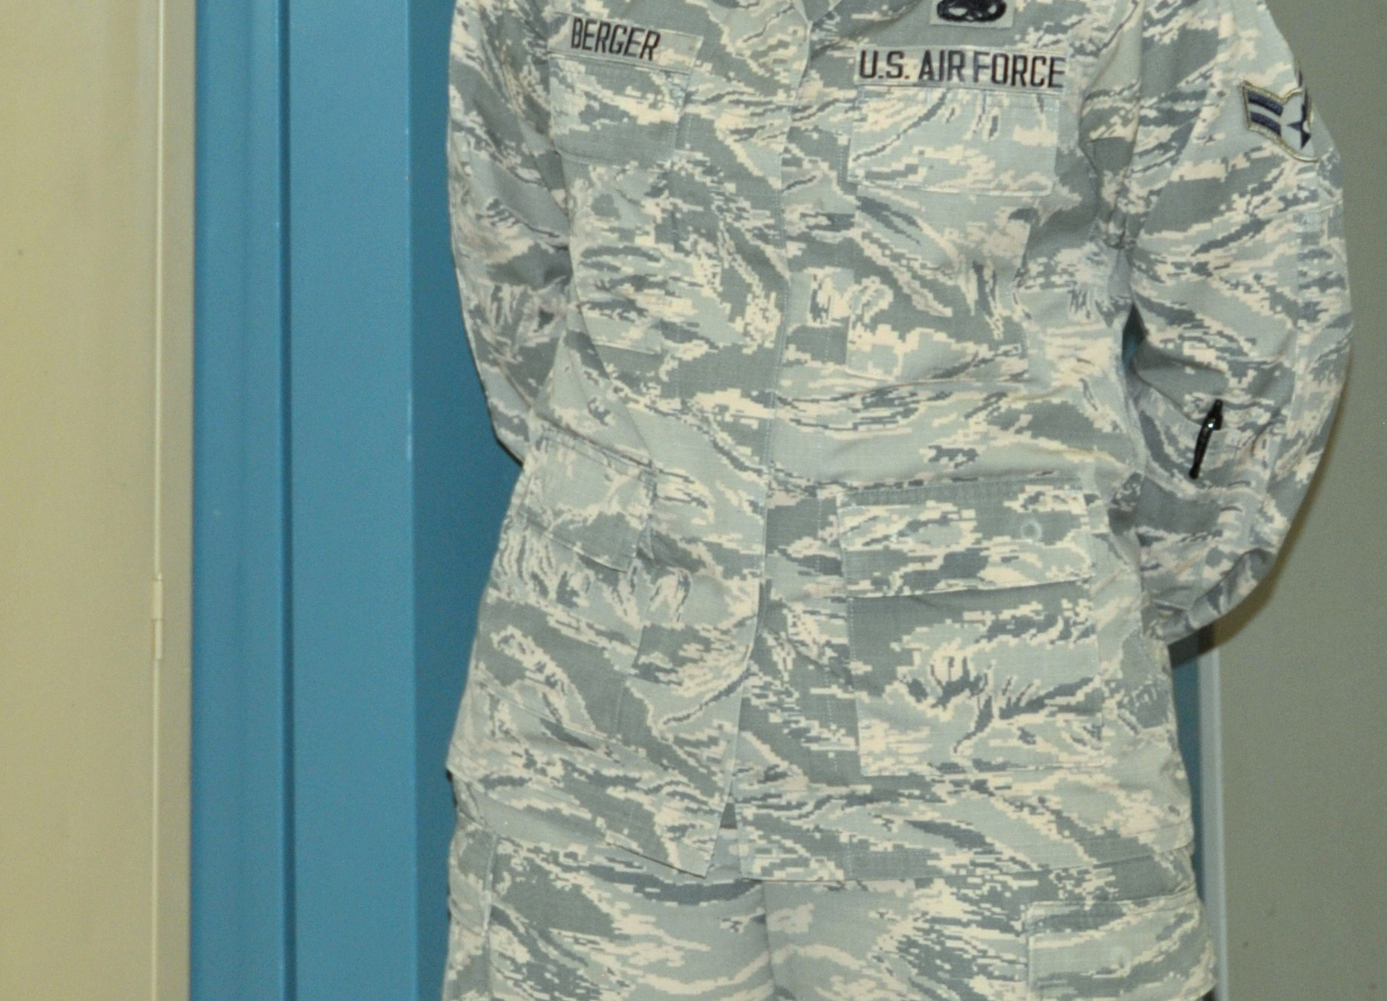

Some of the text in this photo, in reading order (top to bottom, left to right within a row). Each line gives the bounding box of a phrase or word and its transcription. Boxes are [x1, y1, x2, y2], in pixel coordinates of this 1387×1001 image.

[570, 17, 661, 62] BERGER
[858, 49, 1067, 89] U.S. AIR FORCE
